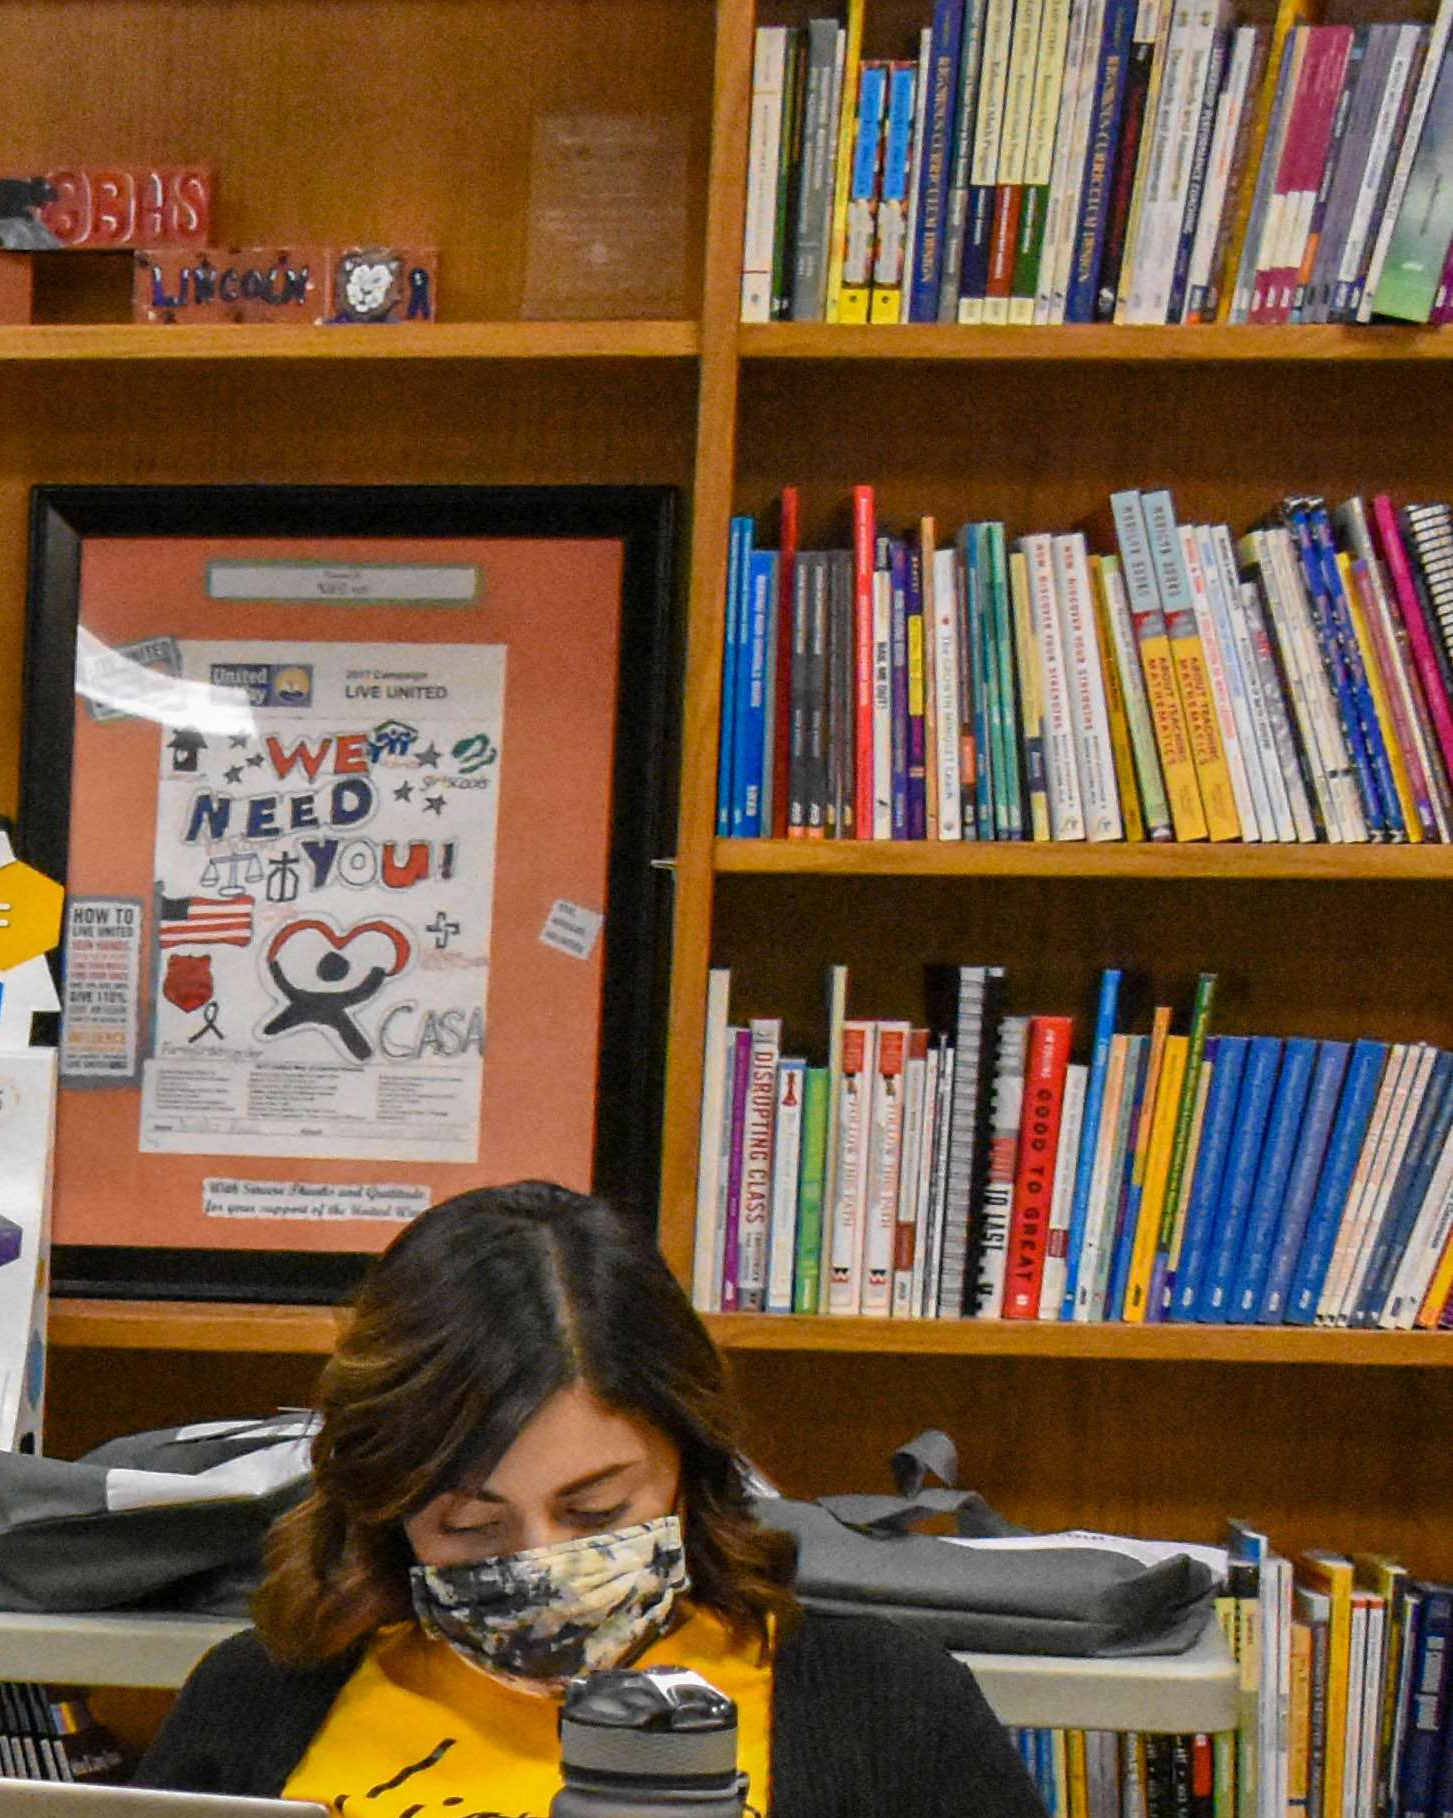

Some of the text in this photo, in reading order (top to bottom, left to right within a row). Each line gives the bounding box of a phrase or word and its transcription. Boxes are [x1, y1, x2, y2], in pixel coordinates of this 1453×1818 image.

[1044, 634, 1056, 662] YOUR
[1072, 635, 1088, 663] YOUR
[1190, 656, 1204, 698] ABOUT
[345, 686, 448, 700] LIVE UNITED
[1148, 658, 1177, 766] MATHEMATICS
[1158, 656, 1172, 698] ABOUT
[1166, 702, 1187, 762] TEACHING
[1181, 658, 1208, 766] MATHEMATICS
[266, 733, 369, 782] WE
[1196, 702, 1219, 762] TEACHING
[184, 776, 376, 842] NEED
[300, 839, 457, 890] YOU!
[73, 908, 134, 924] HOW TO
[378, 1002, 484, 1060] CASA
[745, 1051, 775, 1225] DISRUPTING CLASS
[1017, 1088, 1051, 1285] GOOD TO GREAT
